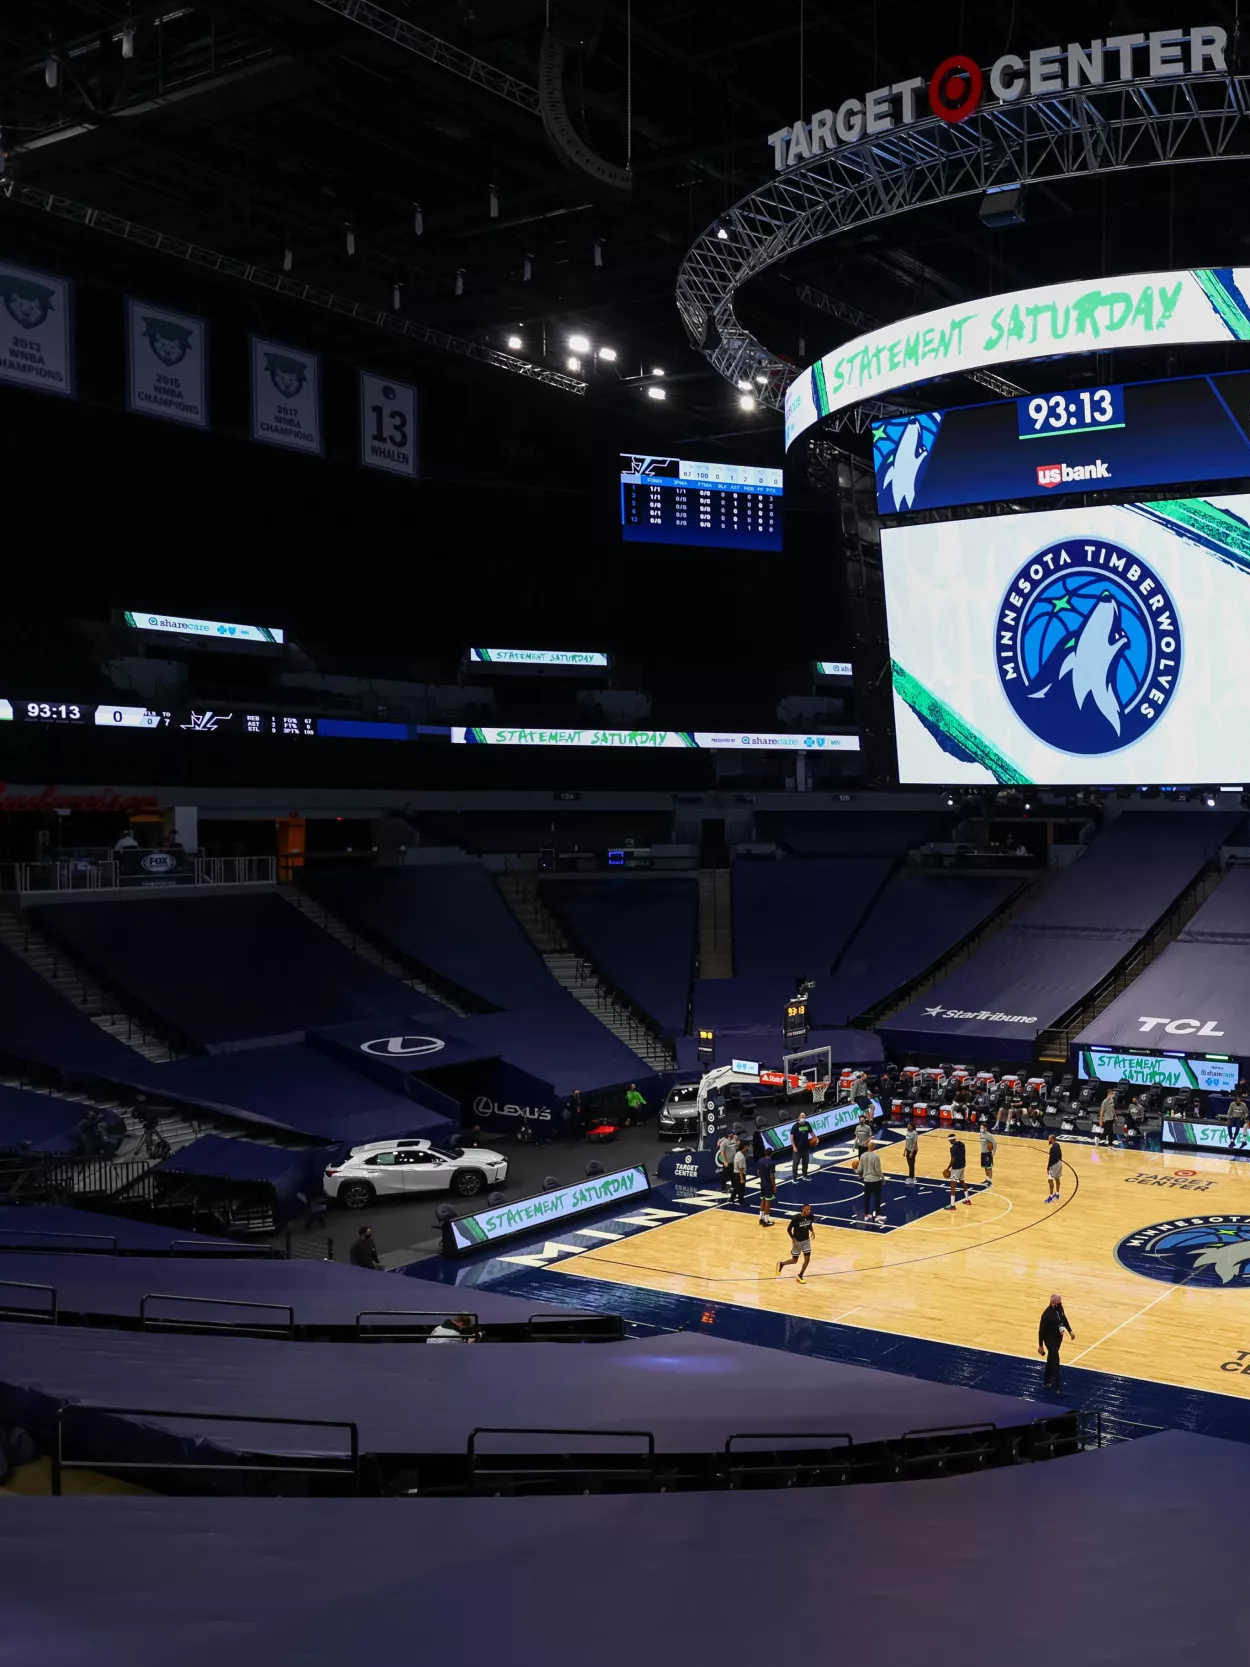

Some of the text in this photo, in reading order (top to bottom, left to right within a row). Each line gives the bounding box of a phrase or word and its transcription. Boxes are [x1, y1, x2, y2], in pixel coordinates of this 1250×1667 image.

[768, 26, 1229, 171] TARGET CENTER
[832, 281, 1183, 395] STATEMENT SATURDAY
[9, 347, 46, 366] WNBA
[155, 374, 181, 388] 2015
[153, 382, 184, 401] WNBA
[137, 390, 200, 416] CHAMPIONS
[276, 405, 298, 418] 2017
[1028, 389, 1113, 430] 93:13
[273, 414, 302, 429] WNBA
[371, 405, 408, 448] 13
[259, 422, 315, 443] CHAMPIONS
[370, 443, 409, 466] WHALEN
[160, 618, 210, 632] sharecare
[1000, 545, 1176, 721] MINNESOTA TIMBERWOLVES
[496, 651, 595, 663] STATEMENT SATURDAY
[27, 703, 81, 720] 93:13
[113, 710, 123, 722] 0
[496, 730, 585, 744] STATEMENT
[591, 731, 667, 746] SATURDAY
[752, 736, 798, 746] sharecare
[1137, 1016, 1224, 1037] TCL
[1098, 1055, 1166, 1070] STATEMENT
[1122, 1069, 1181, 1085] SATURDAY
[1206, 1070, 1234, 1078] sharecare
[494, 1104, 552, 1121] LEXUS
[675, 1170, 697, 1178] CENTER
[1135, 1172, 1218, 1187] TARGET
[1124, 1177, 1211, 1193] CENTER
[486, 1171, 635, 1233] STATEMENT SATURDAY
